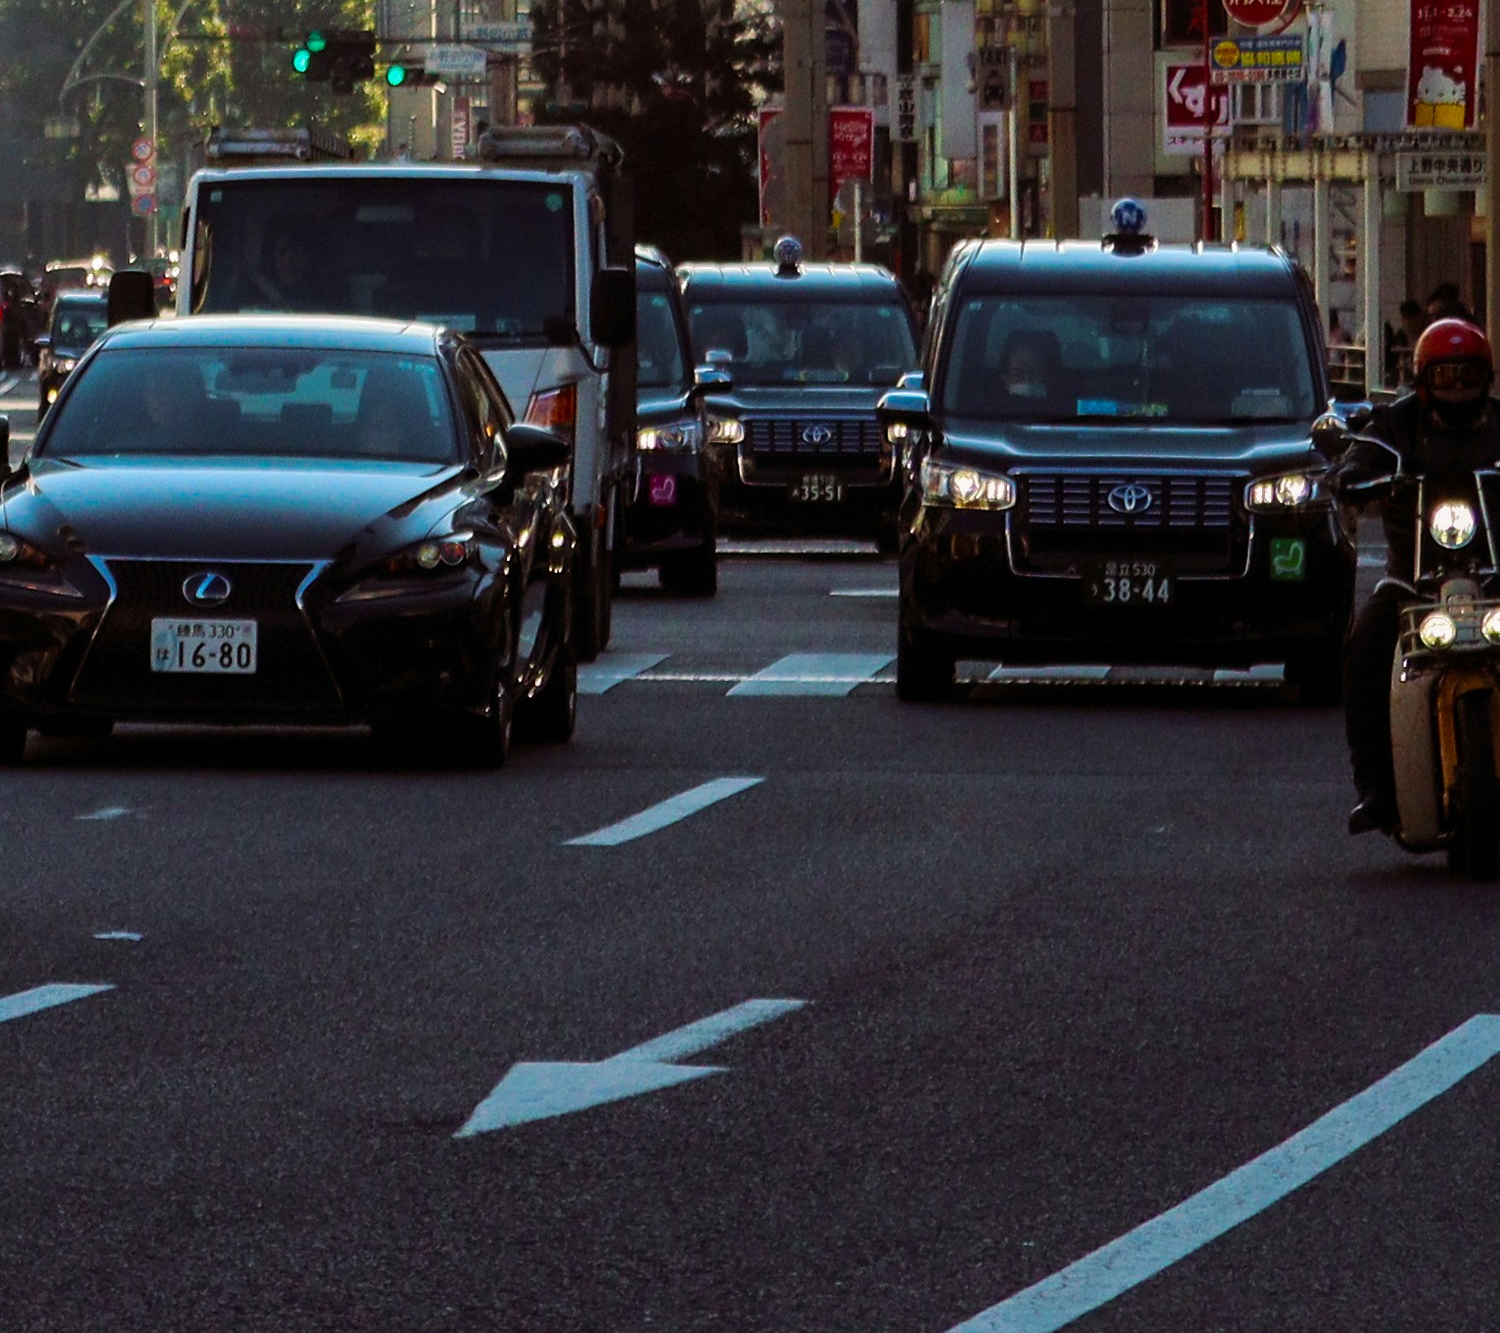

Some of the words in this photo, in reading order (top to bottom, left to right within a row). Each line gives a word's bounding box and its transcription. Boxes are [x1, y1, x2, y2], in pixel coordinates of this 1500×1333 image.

[1408, 158, 1486, 173] 上野中央通り
[800, 484, 842, 501] 35-51
[1133, 561, 1157, 578] 530
[1103, 577, 1170, 604] 38-44
[176, 624, 205, 638] 練馬
[208, 624, 236, 639] 330
[178, 641, 252, 669] 16-80
